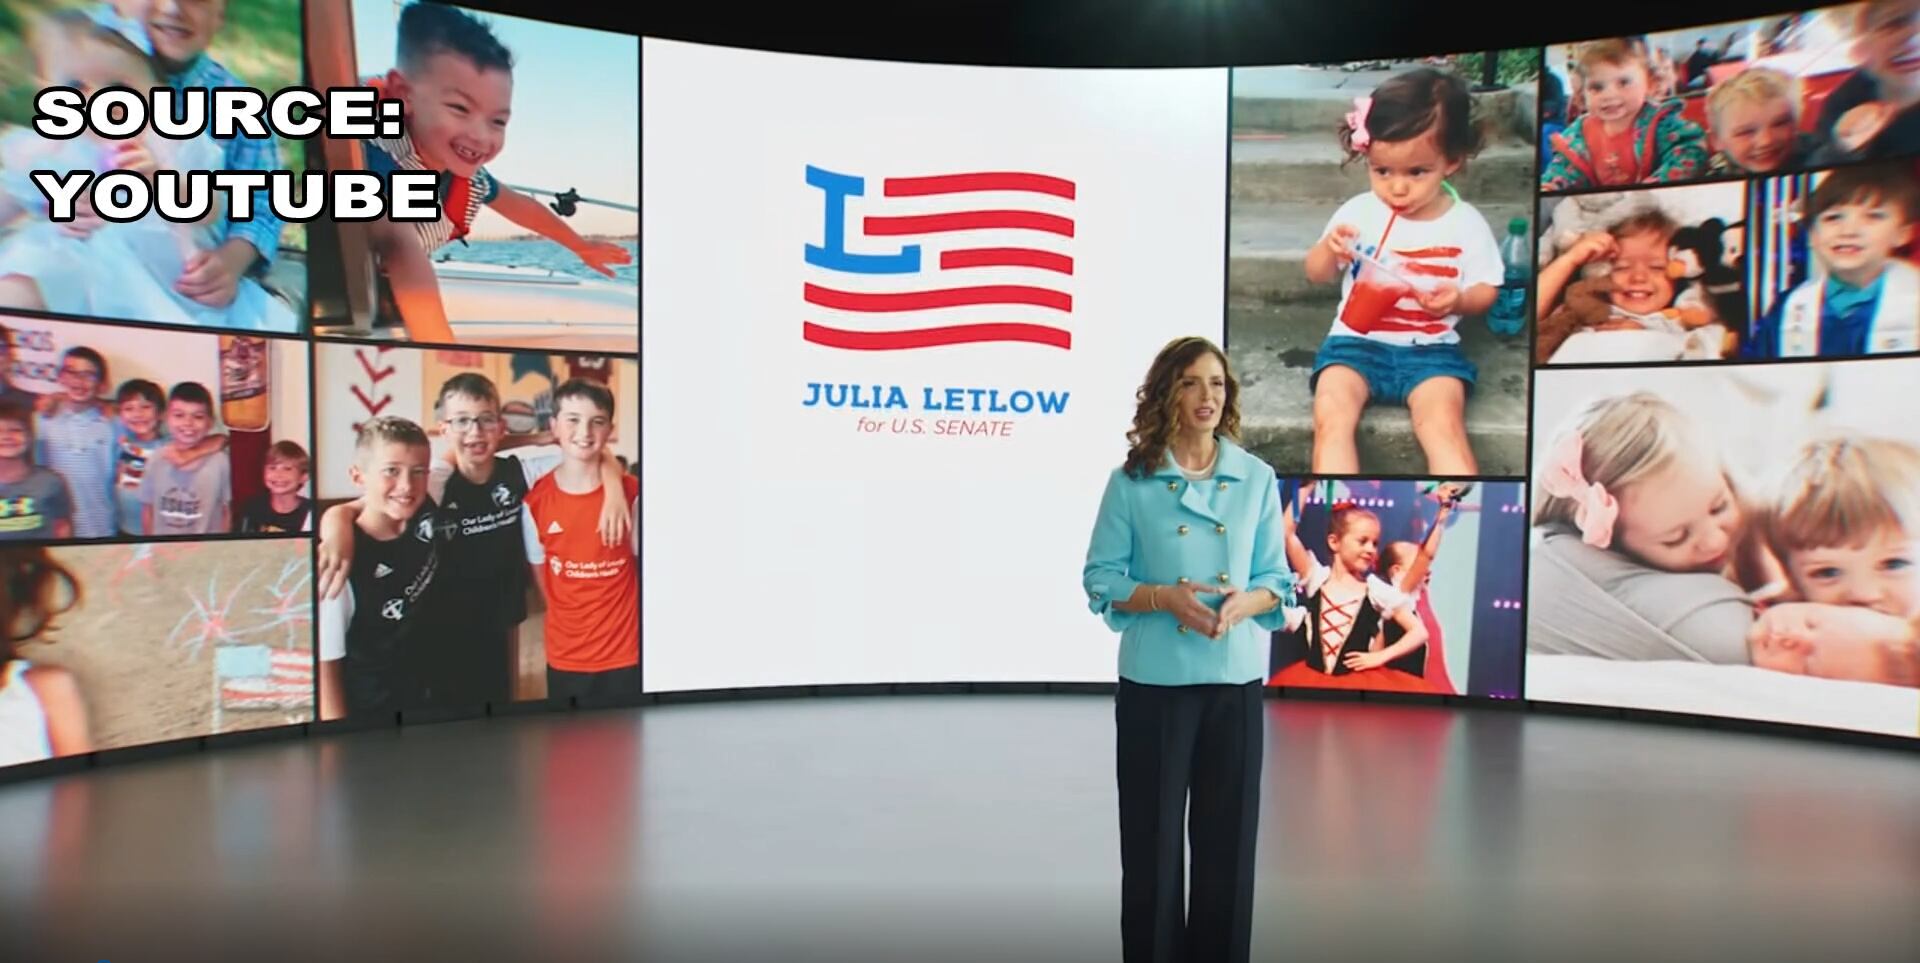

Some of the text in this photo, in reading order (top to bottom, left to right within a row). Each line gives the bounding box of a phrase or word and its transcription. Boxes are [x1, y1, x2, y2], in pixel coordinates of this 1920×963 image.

[805, 164, 921, 275] L
[803, 382, 1071, 413] JULIA LETLOW
[856, 416, 1015, 437] for U.S. SENATE
